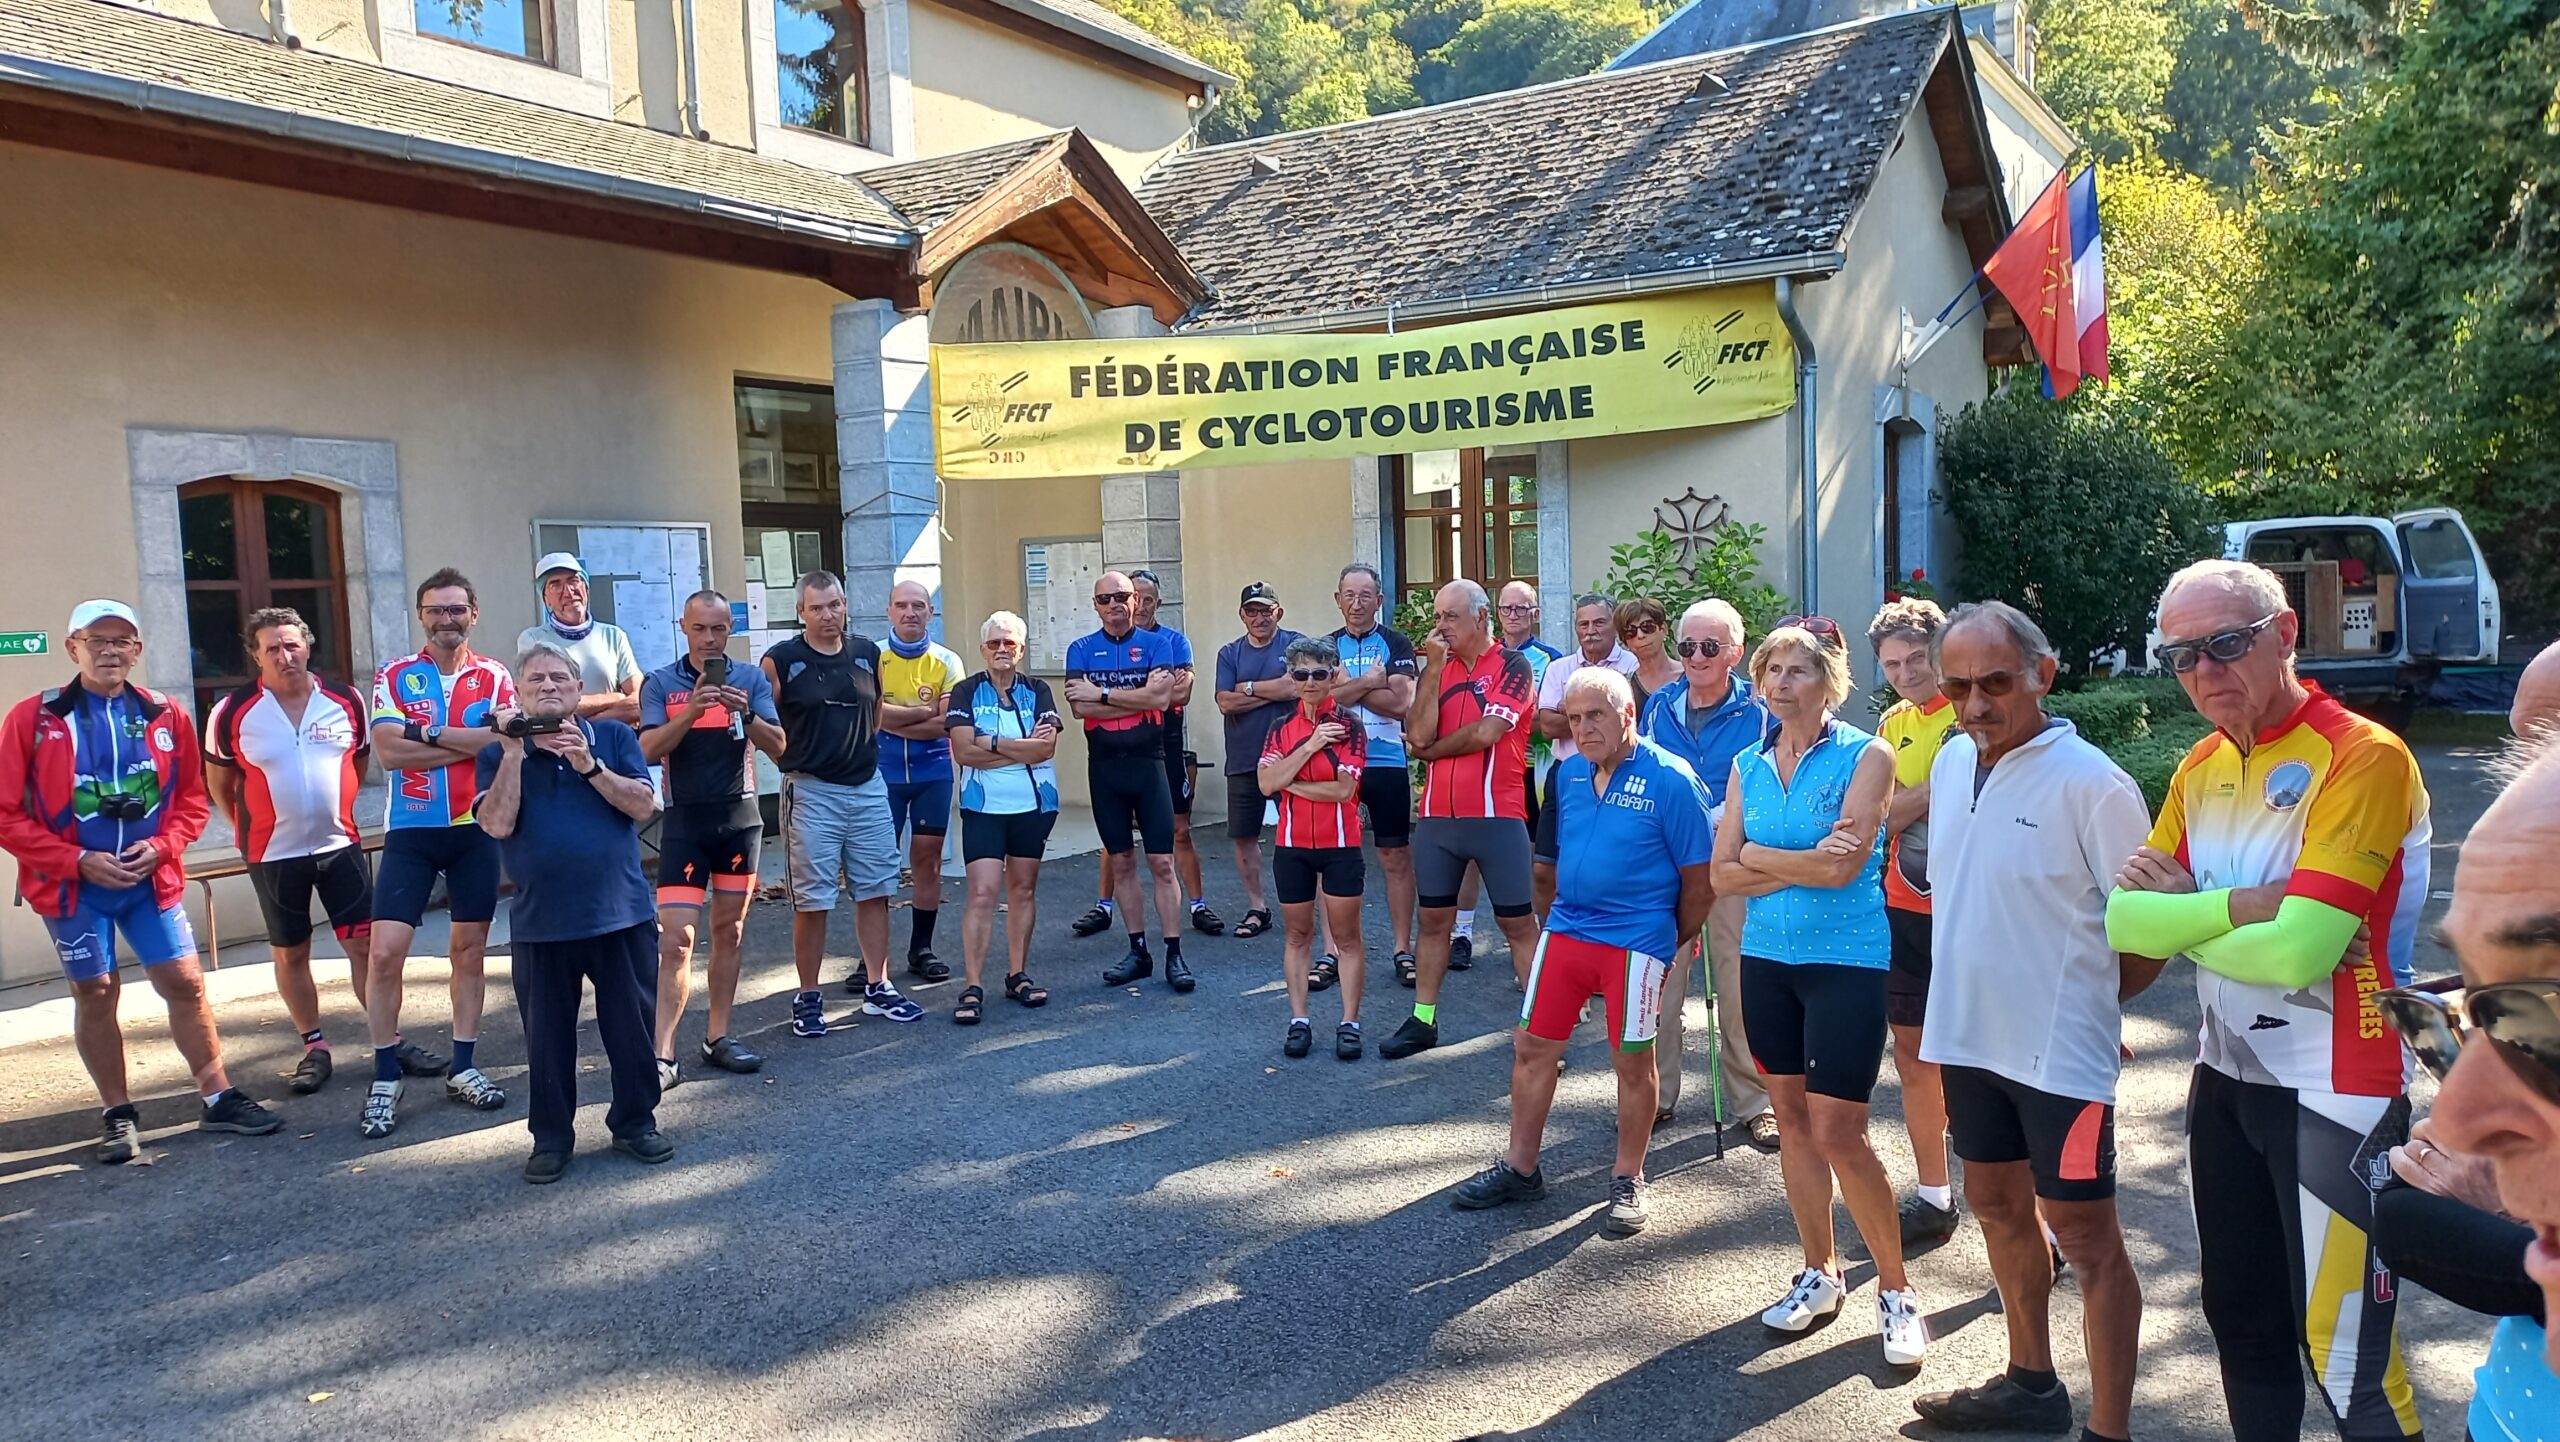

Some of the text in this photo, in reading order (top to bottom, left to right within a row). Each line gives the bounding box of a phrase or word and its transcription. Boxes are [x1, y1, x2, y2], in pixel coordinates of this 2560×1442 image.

[1069, 320, 1646, 398] FÉDÉRATION FRANÇAISE
[1717, 340, 1770, 364] FFCT
[1003, 402, 1053, 423] FFCT
[1125, 385, 1594, 453] DE CYCLOTOURISME
